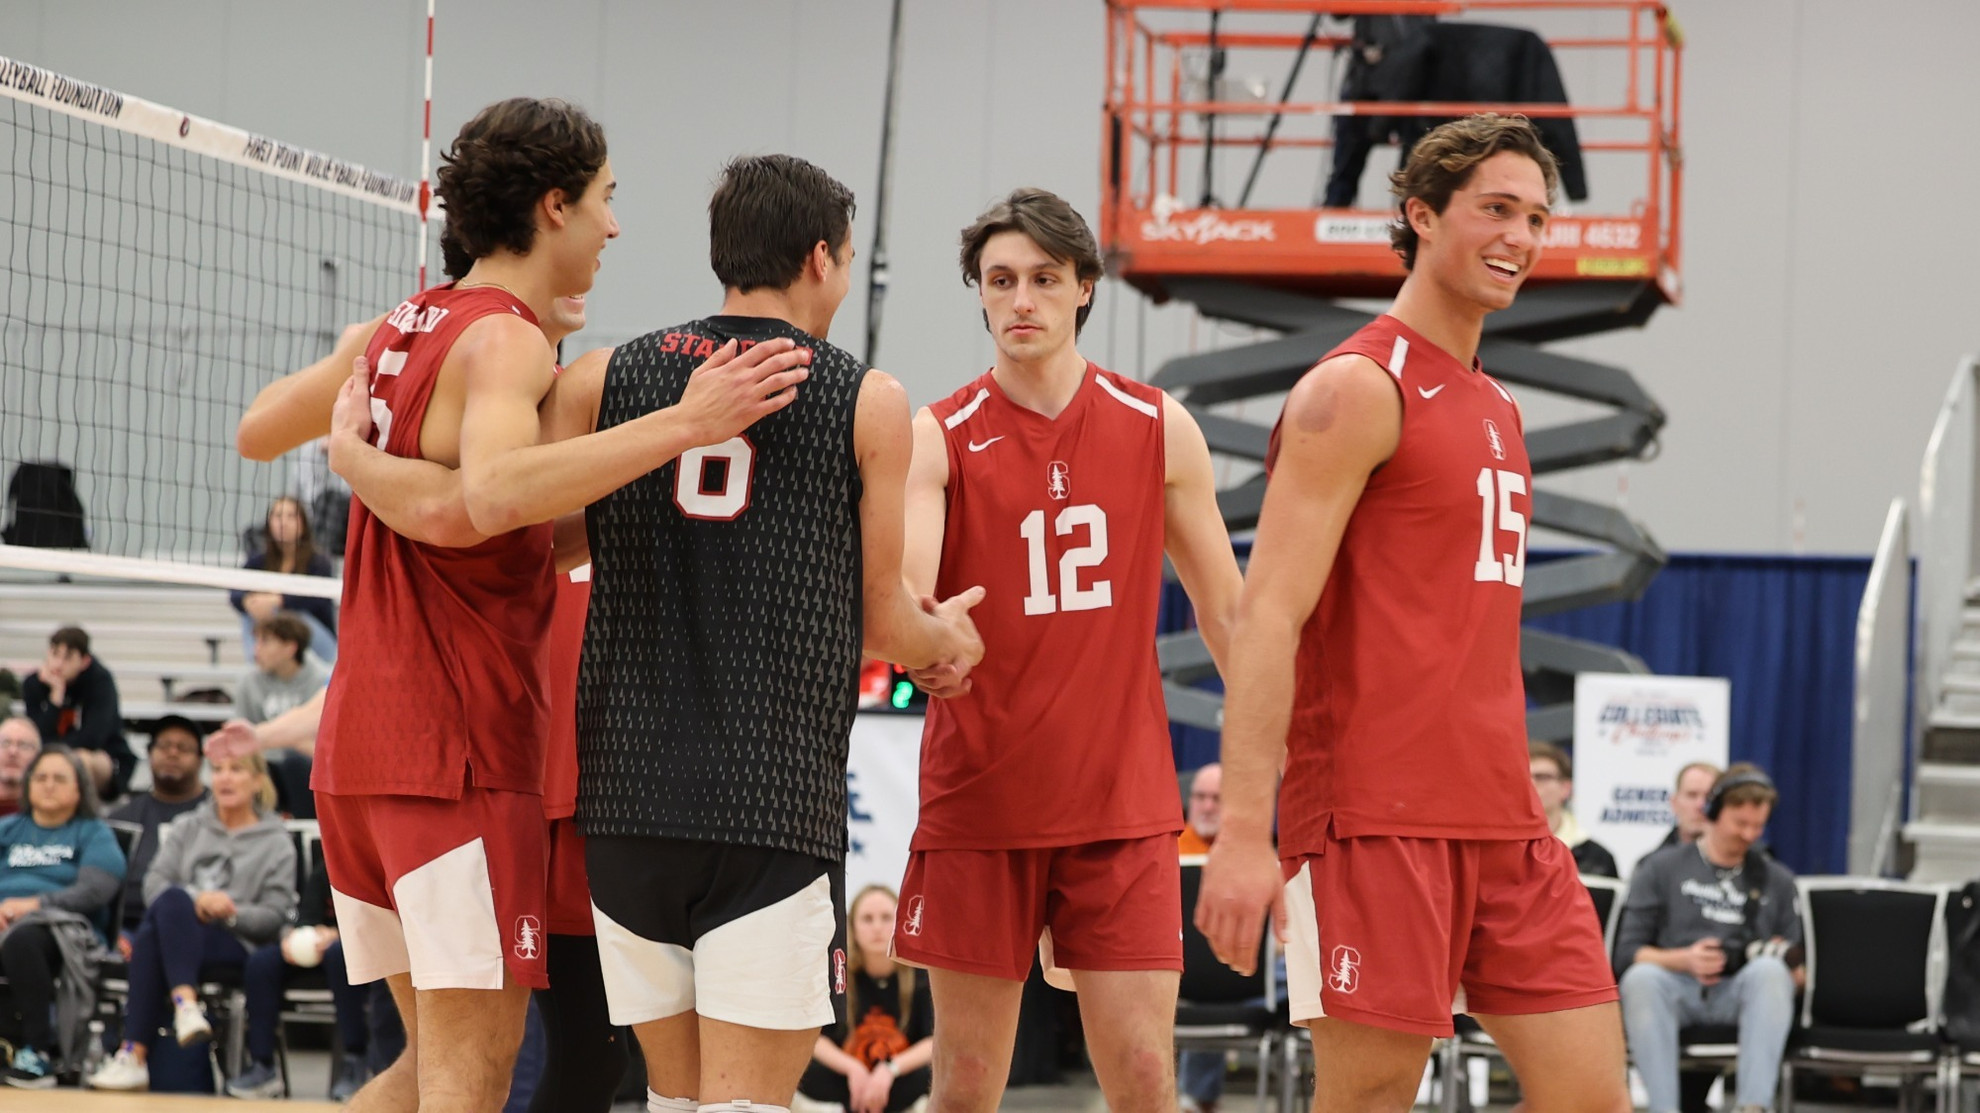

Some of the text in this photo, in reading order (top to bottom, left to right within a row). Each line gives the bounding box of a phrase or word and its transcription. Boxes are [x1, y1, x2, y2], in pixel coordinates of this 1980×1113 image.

[0, 60, 124, 119] LEYBALL FOUNDATION
[273, 144, 305, 172] POINT
[1141, 214, 1276, 245] SKYJACK
[1474, 467, 1527, 588] 15
[1020, 503, 1112, 616] 12
[1613, 786, 1670, 802] GENER
